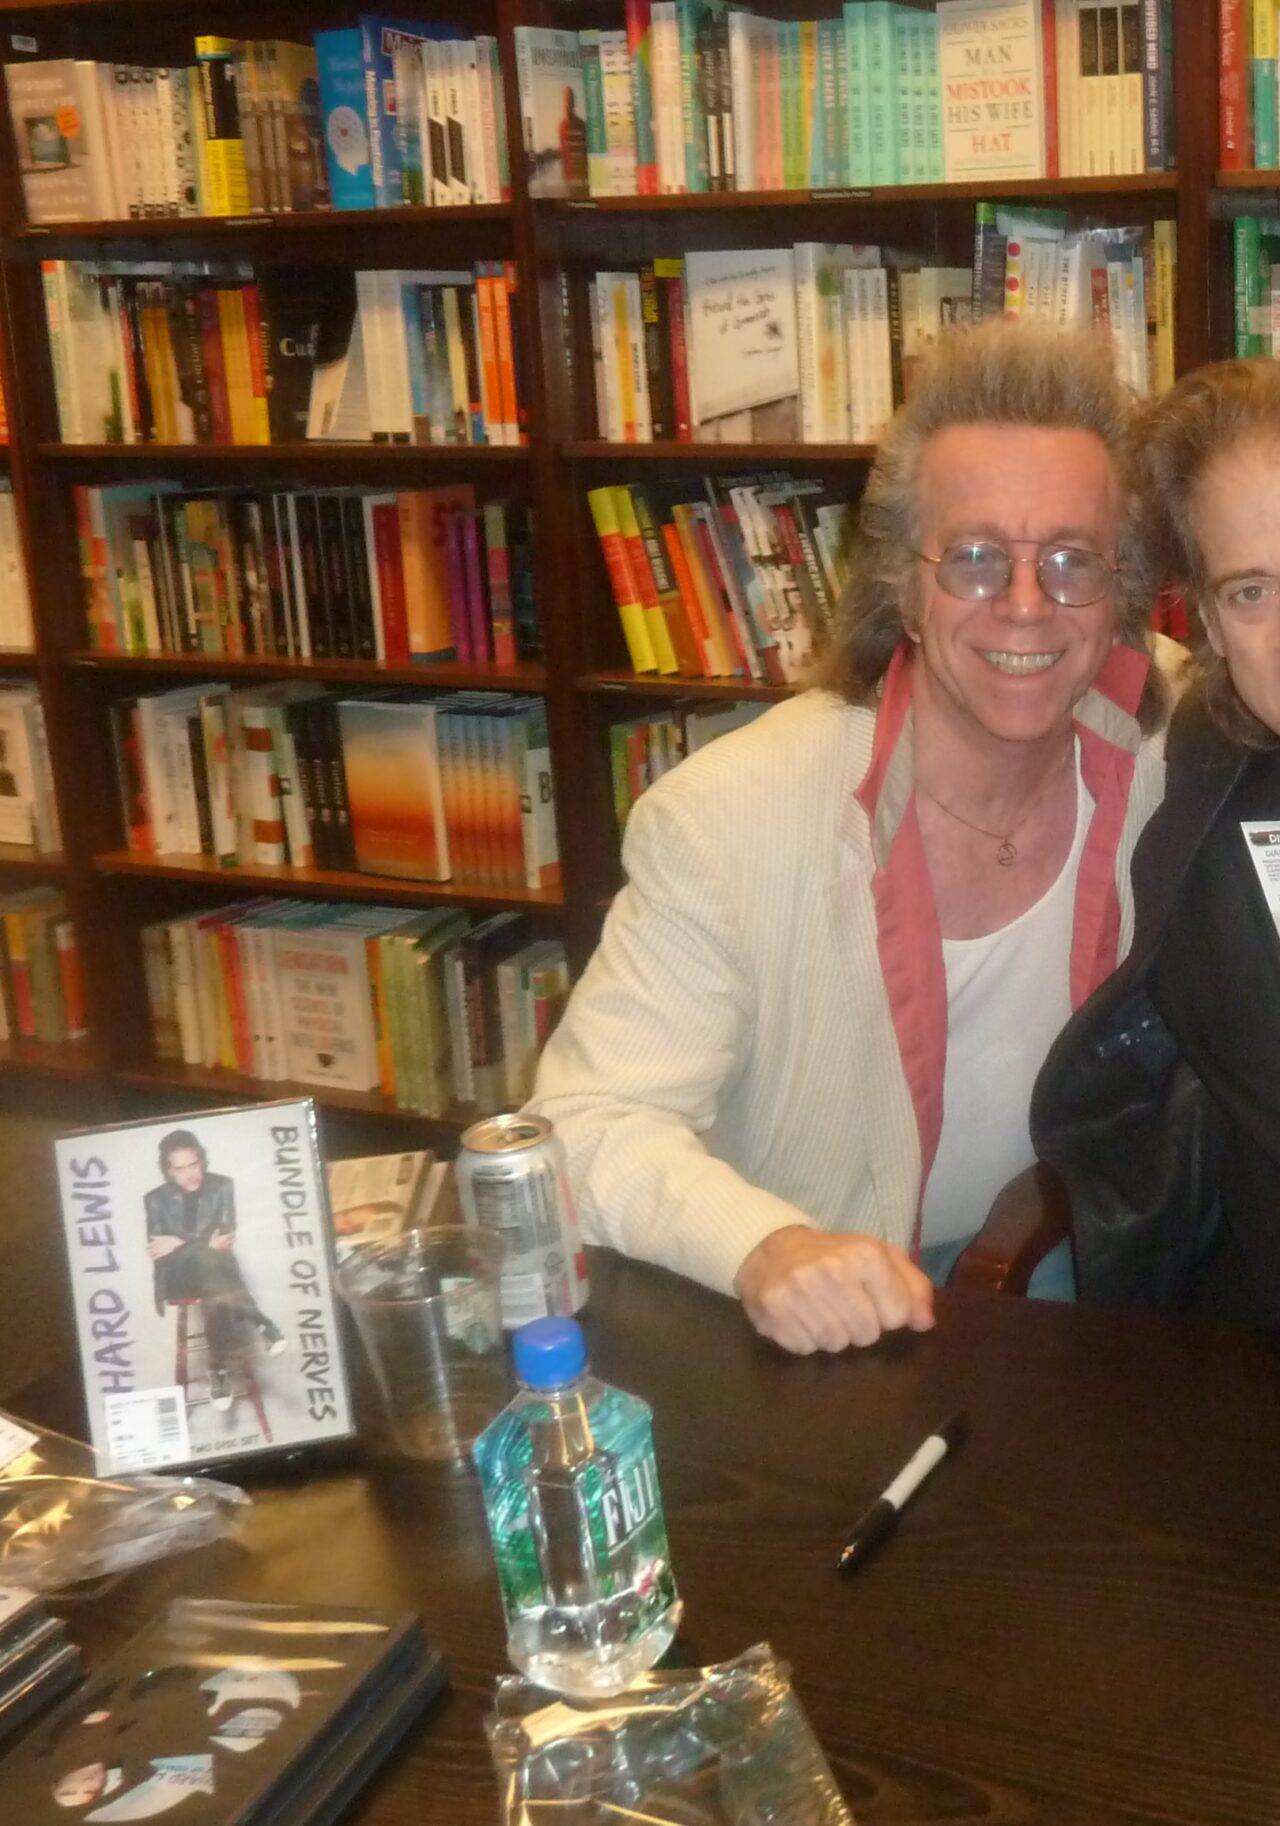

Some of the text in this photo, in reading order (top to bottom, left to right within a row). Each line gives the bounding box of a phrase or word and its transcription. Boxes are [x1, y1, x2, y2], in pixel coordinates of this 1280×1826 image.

[965, 45, 1012, 66] MAN
[1146, 42, 1158, 69] MIND
[1221, 31, 1236, 66] Voice
[946, 78, 1032, 100] MISTOOK
[948, 101, 1033, 124] HIS WIFE
[971, 133, 1011, 154] HAT
[1234, 228, 1248, 292] Overcoming
[798, 533, 821, 590] AMERICAN
[69, 1155, 137, 1396] HARD LEWIS
[270, 1124, 339, 1423] BUNDLE OF NERVES
[189, 1433, 261, 1456] TWO DISC SET
[602, 1459, 656, 1547] FIJI
